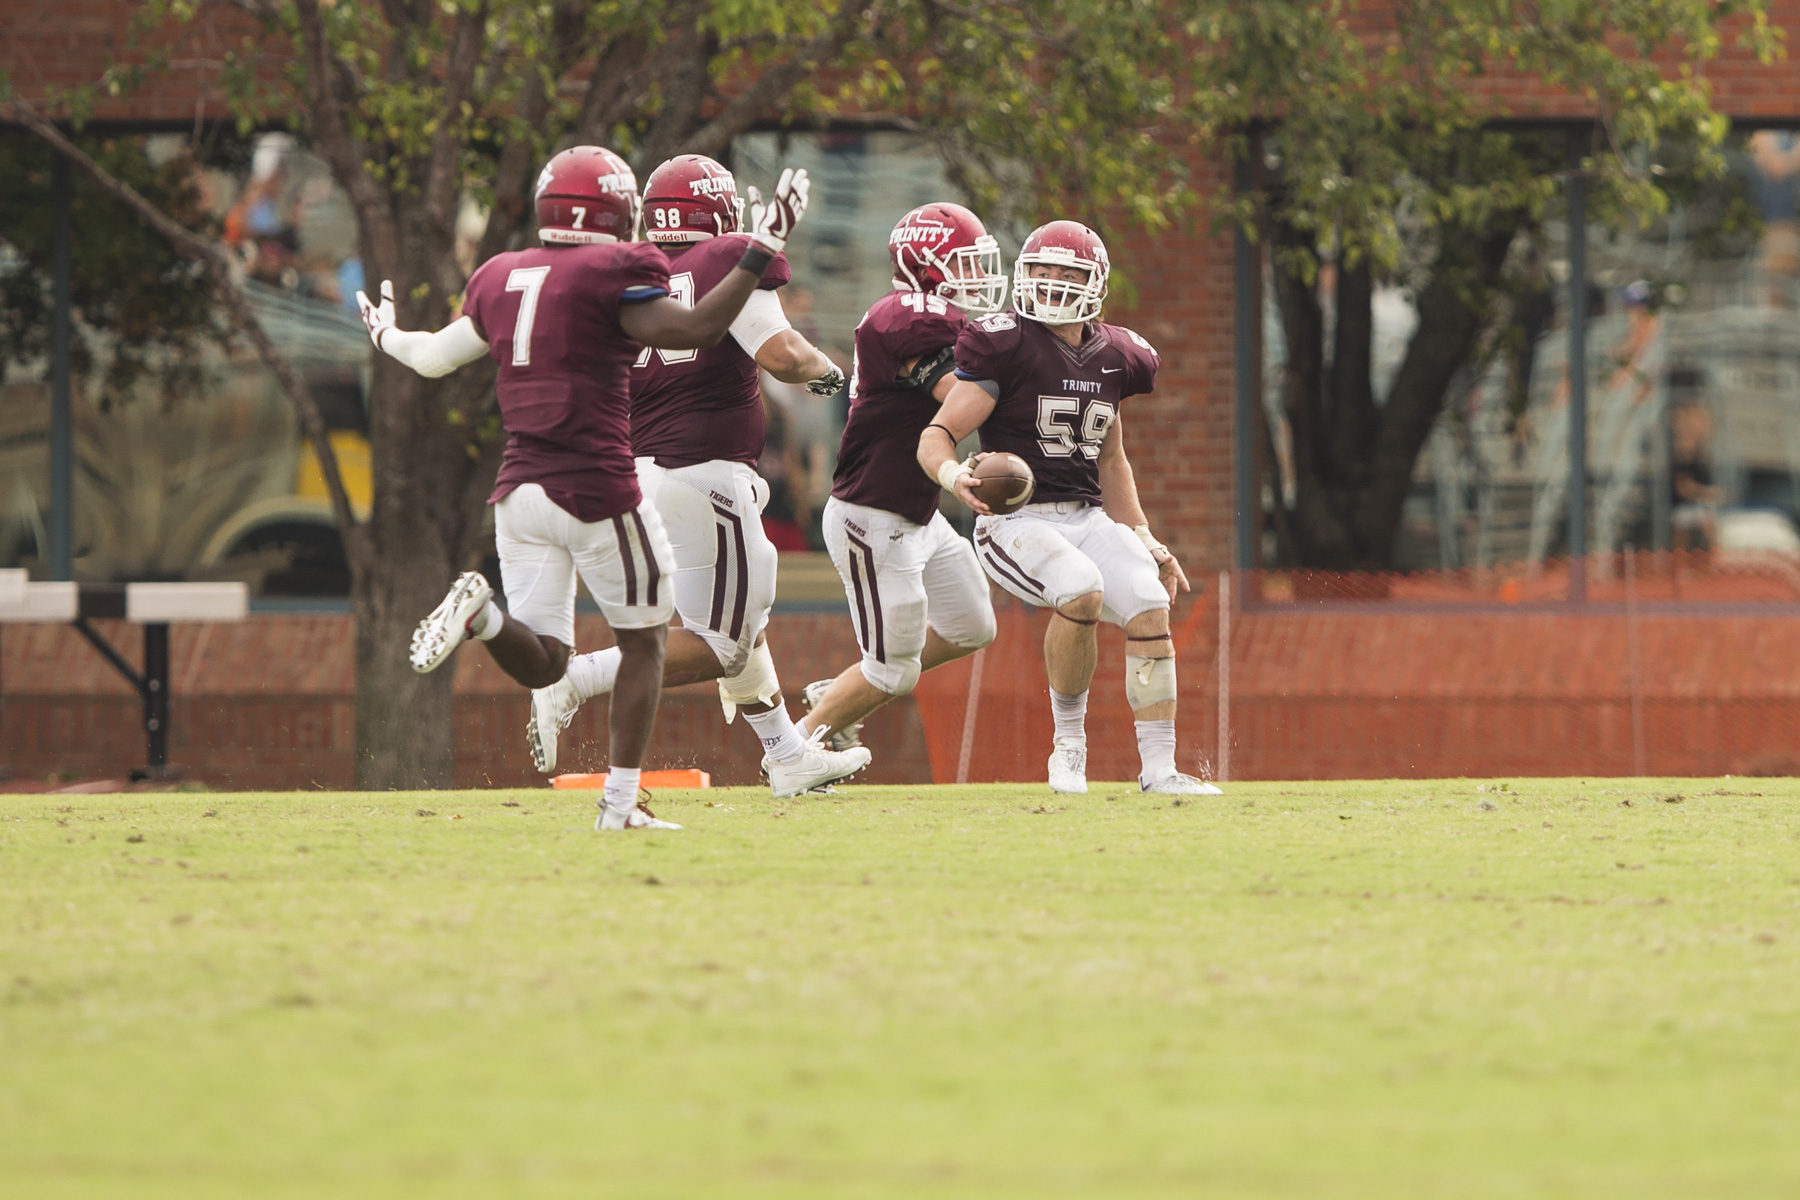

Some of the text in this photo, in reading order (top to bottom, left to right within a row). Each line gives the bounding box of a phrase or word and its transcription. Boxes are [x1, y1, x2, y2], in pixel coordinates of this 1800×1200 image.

[571, 206, 587, 229] 7
[655, 207, 681, 229] 98
[551, 232, 592, 243] Riddell
[652, 233, 688, 241] Riddell
[900, 292, 948, 316] 45
[505, 265, 551, 366] 7
[1062, 379, 1102, 394] TRINITY
[1036, 394, 1116, 460] 59
[709, 489, 734, 508] TIGERS
[844, 517, 867, 537] TIGERS
